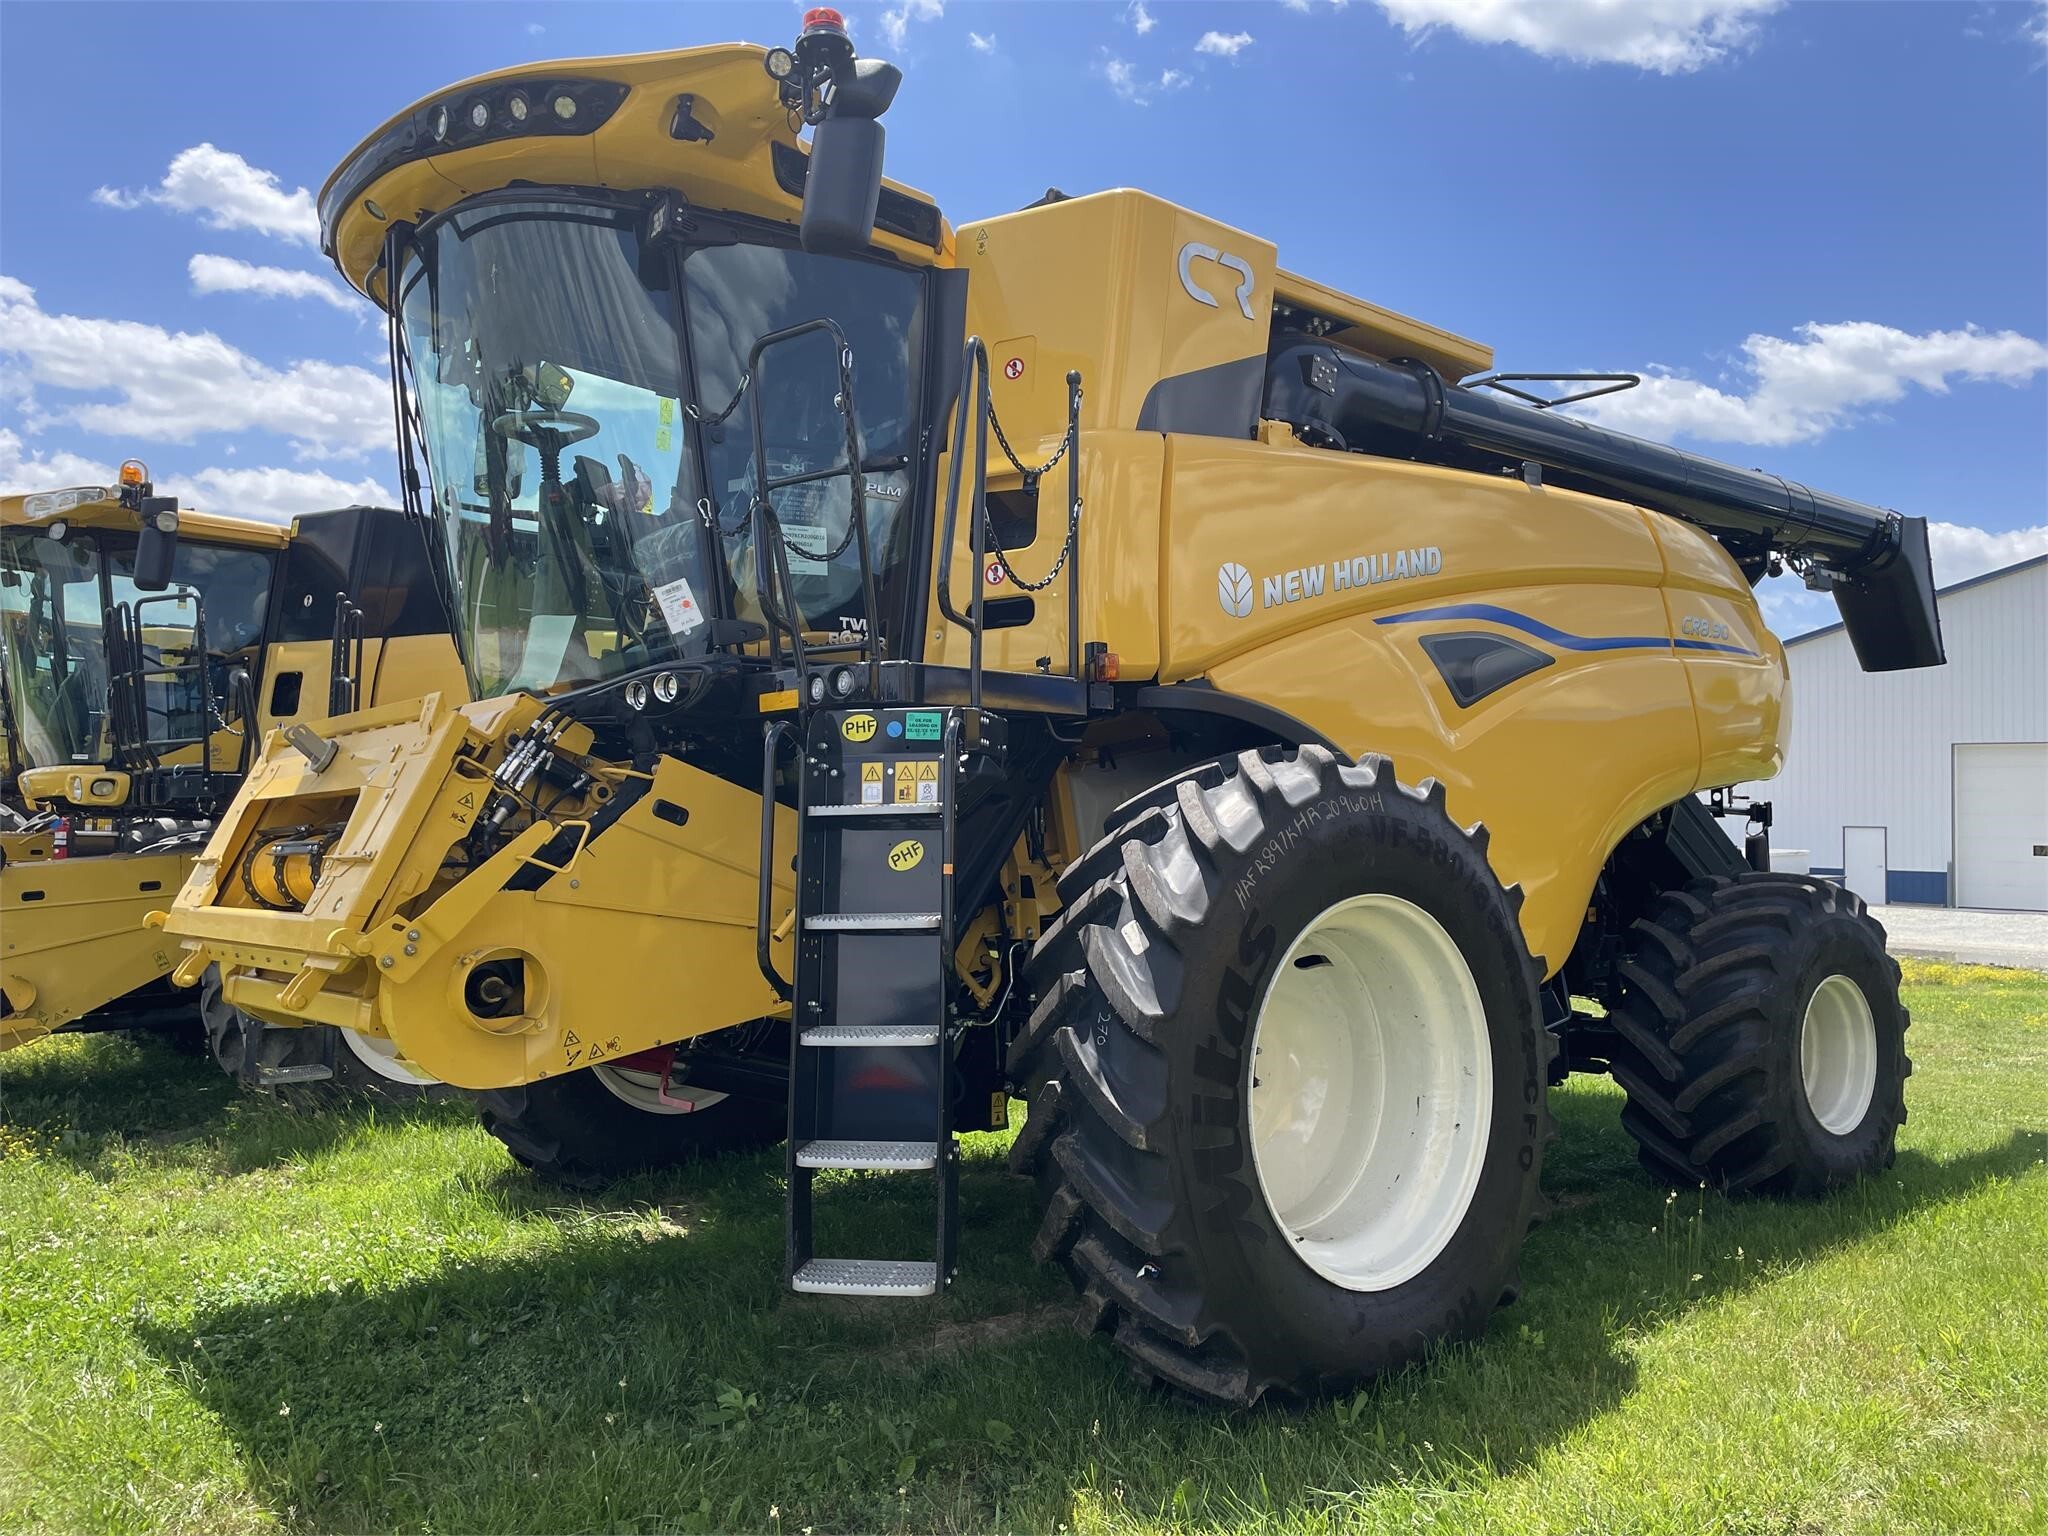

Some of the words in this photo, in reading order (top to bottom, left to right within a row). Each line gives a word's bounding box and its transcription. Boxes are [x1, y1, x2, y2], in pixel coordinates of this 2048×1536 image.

[1178, 241, 1255, 320] CR
[865, 483, 902, 497] PLM
[1263, 564, 1326, 609] NEW
[1333, 546, 1442, 592] HOLLAND
[845, 719, 876, 735] PHF
[890, 841, 920, 867] PHF
